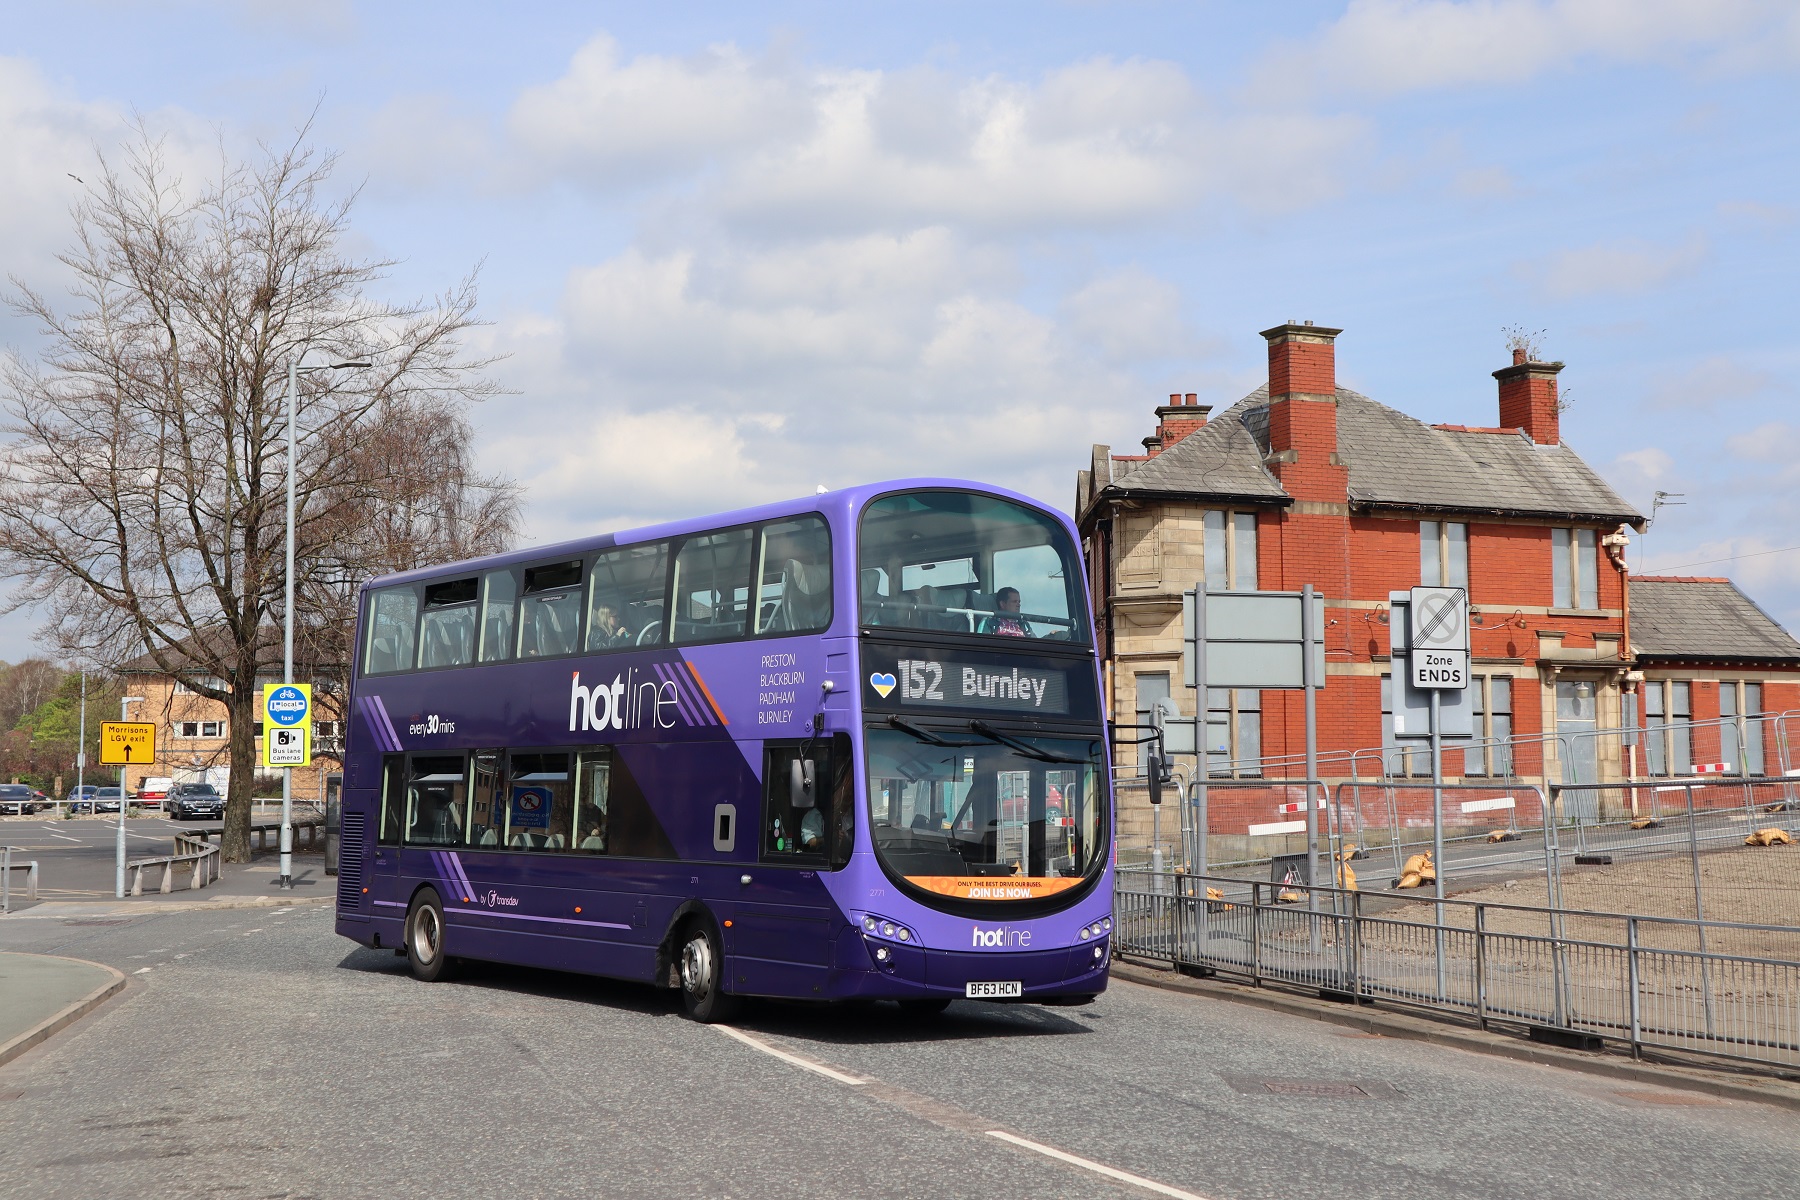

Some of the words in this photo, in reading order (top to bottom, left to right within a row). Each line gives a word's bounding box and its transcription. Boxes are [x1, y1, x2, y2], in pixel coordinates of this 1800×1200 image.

[761, 653, 796, 668] PRESTON
[1426, 654, 1453, 666] Zone
[760, 671, 805, 687] BLACKBURN
[897, 659, 944, 701] 152
[962, 666, 1047, 707] Burnley
[1419, 669, 1461, 683] ENDS
[569, 666, 678, 732] hotline
[759, 690, 796, 705] PADIHAM
[758, 709, 793, 725] BURNLEY
[108, 726, 148, 734] Morrisons
[409, 723, 427, 738] every
[427, 714, 439, 734] 30
[439, 718, 455, 734] mins
[480, 894, 487, 906] by
[496, 895, 519, 906] transdev
[869, 888, 885, 897] 2771
[968, 888, 991, 898] JOIN
[991, 888, 1005, 898] US
[1006, 888, 1033, 898] NOW.
[972, 925, 1032, 947] hotline
[970, 983, 997, 995] BF63
[998, 983, 1018, 995] HCN
